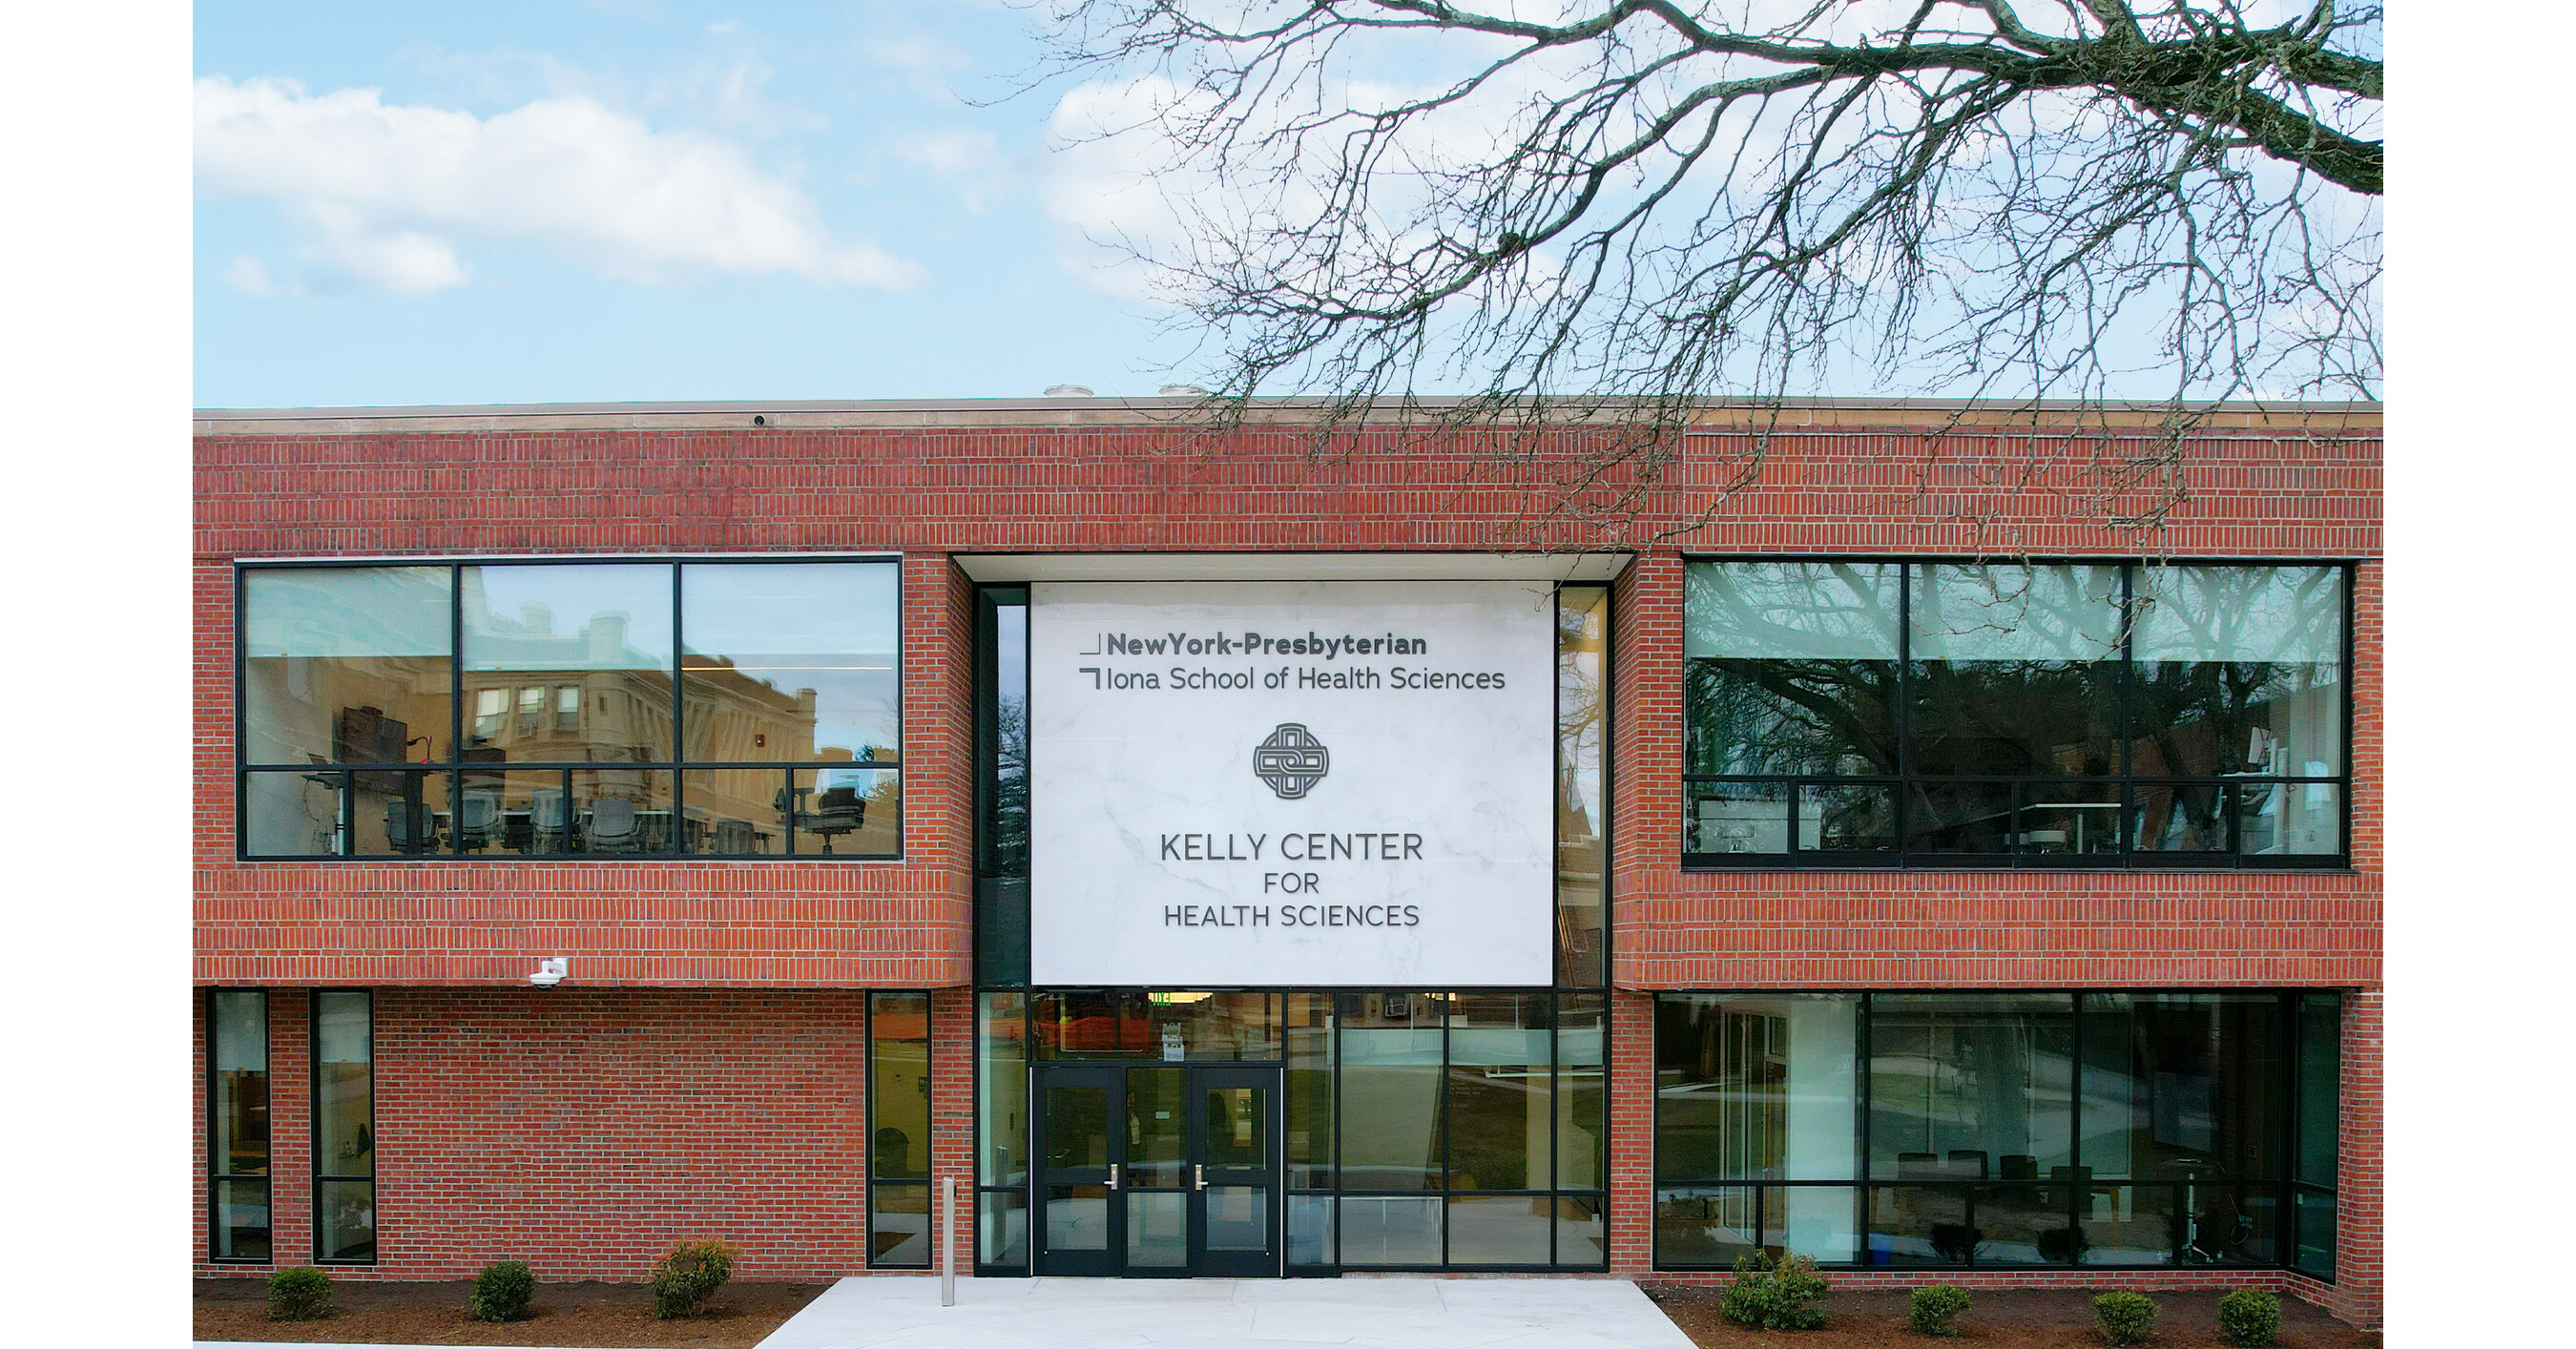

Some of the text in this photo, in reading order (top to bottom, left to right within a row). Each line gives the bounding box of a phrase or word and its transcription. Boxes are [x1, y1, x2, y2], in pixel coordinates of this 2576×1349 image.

[1107, 631, 1427, 660] NewYork-Presbyterian
[1107, 666, 1506, 690] Iona School of Health Sciences
[1161, 833, 1423, 861] KELLY CENTER
[1264, 872, 1319, 894] FOR
[1164, 904, 1420, 927] HEALTH SCIENCES
